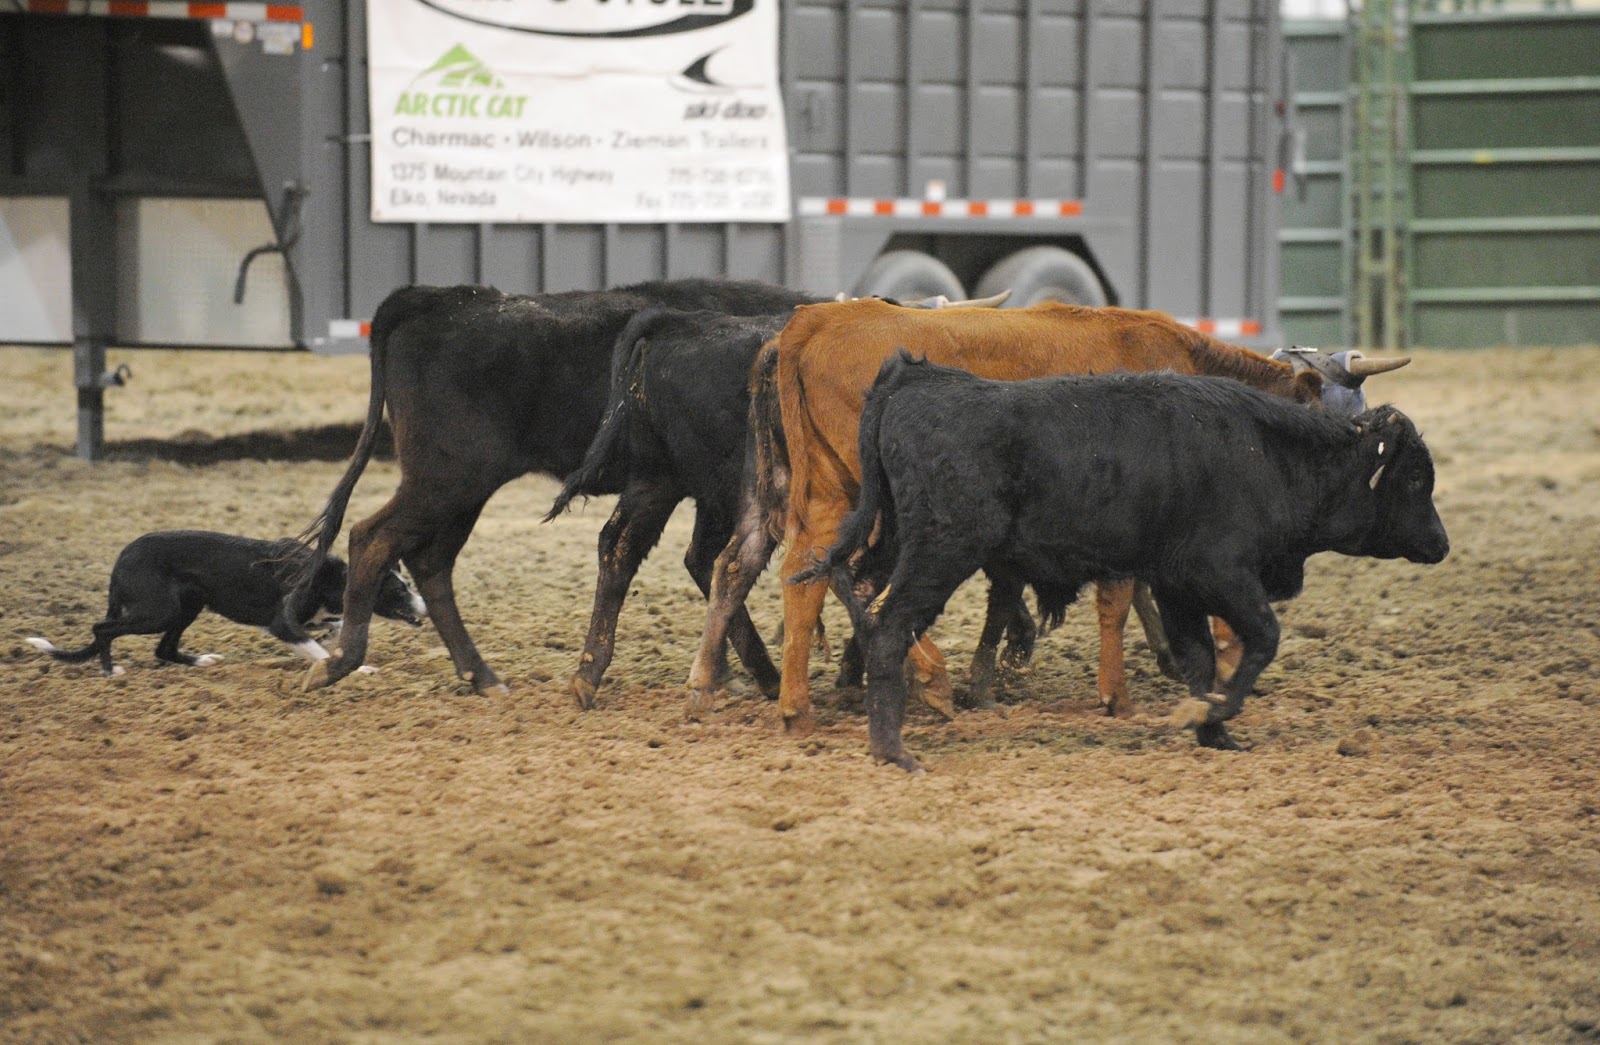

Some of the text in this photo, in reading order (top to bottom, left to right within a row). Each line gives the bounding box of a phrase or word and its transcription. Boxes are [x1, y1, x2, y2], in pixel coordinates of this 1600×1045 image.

[394, 92, 528, 118] ARCTIC CAT
[392, 126, 496, 149] Charmac
[517, 128, 592, 149] Wilson
[434, 164, 507, 182] Mountain
[437, 189, 497, 207] Nevada
